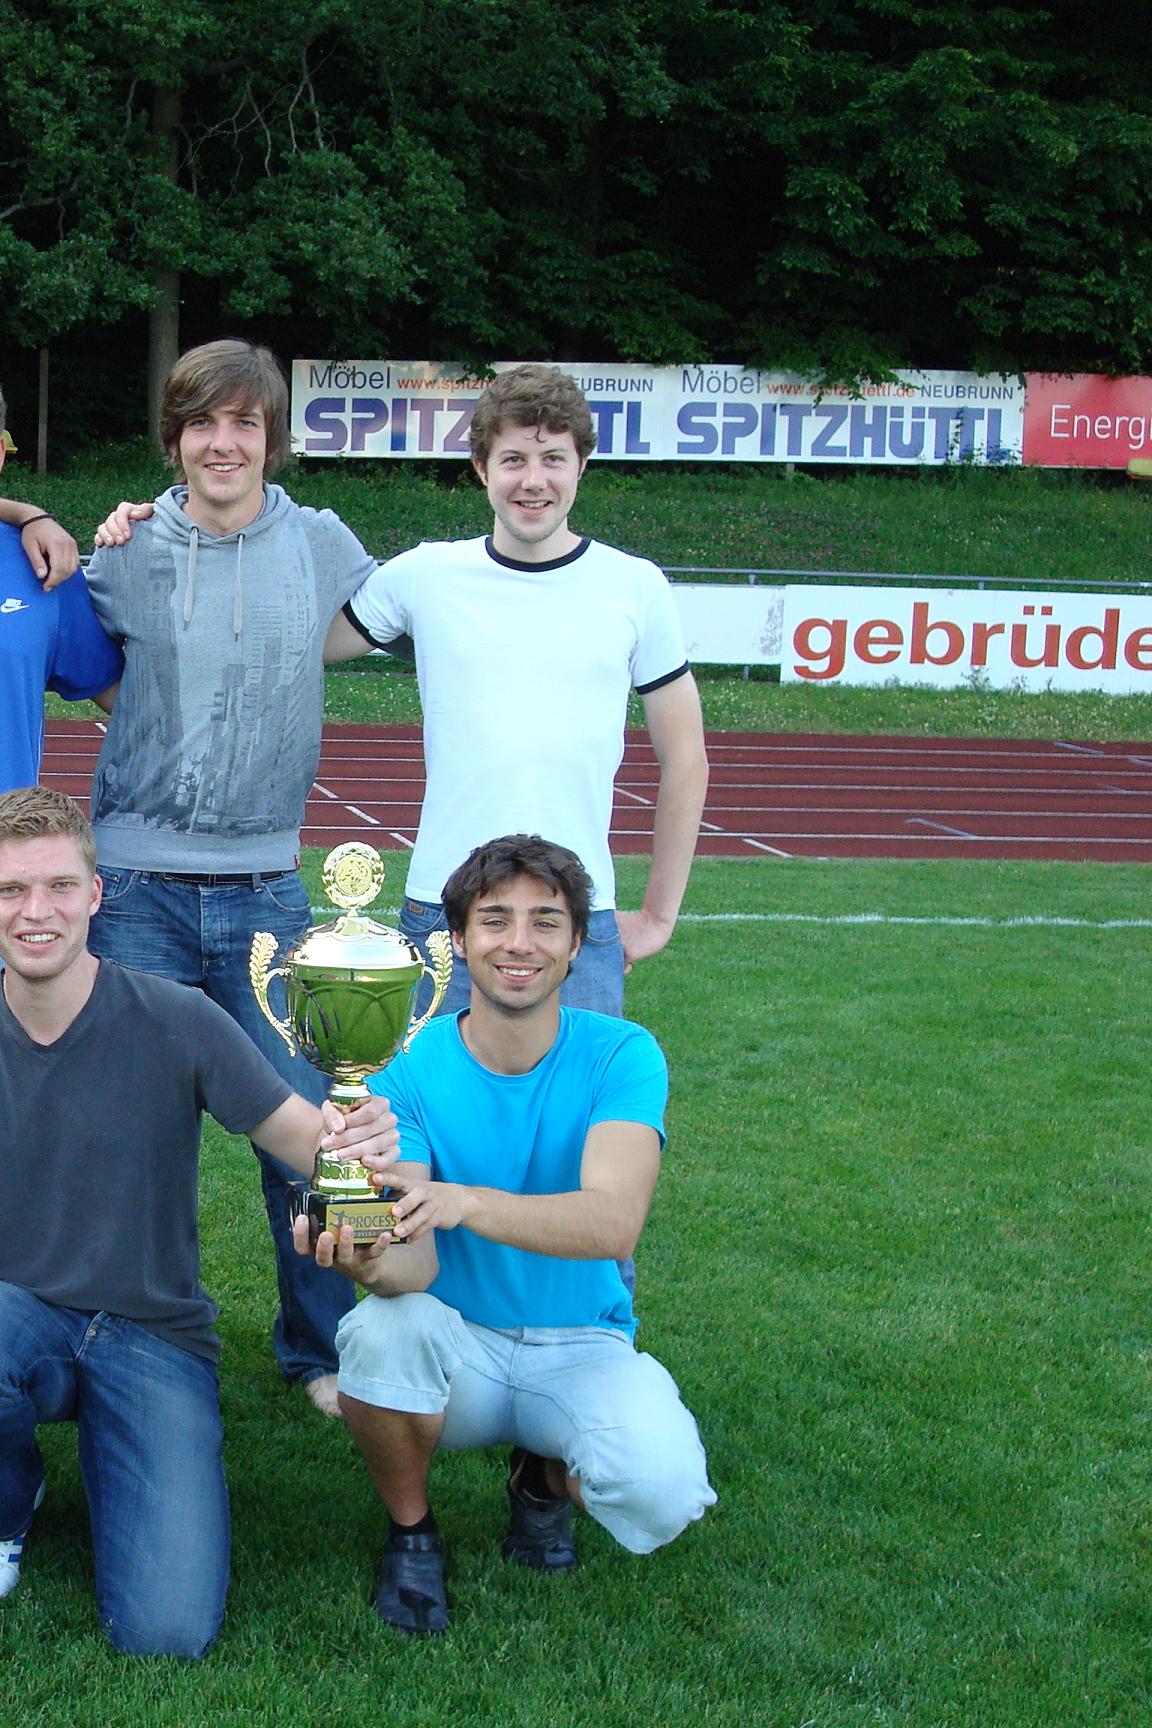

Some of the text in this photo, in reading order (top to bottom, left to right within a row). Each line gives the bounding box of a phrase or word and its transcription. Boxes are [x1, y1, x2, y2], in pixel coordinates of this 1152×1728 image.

[309, 365, 391, 390] Möbel
[575, 377, 654, 393] UBRUNN
[682, 368, 761, 395] Möbel
[921, 384, 1015, 401] NEUBRUNN
[349, 1214, 397, 1228] PROCESS
